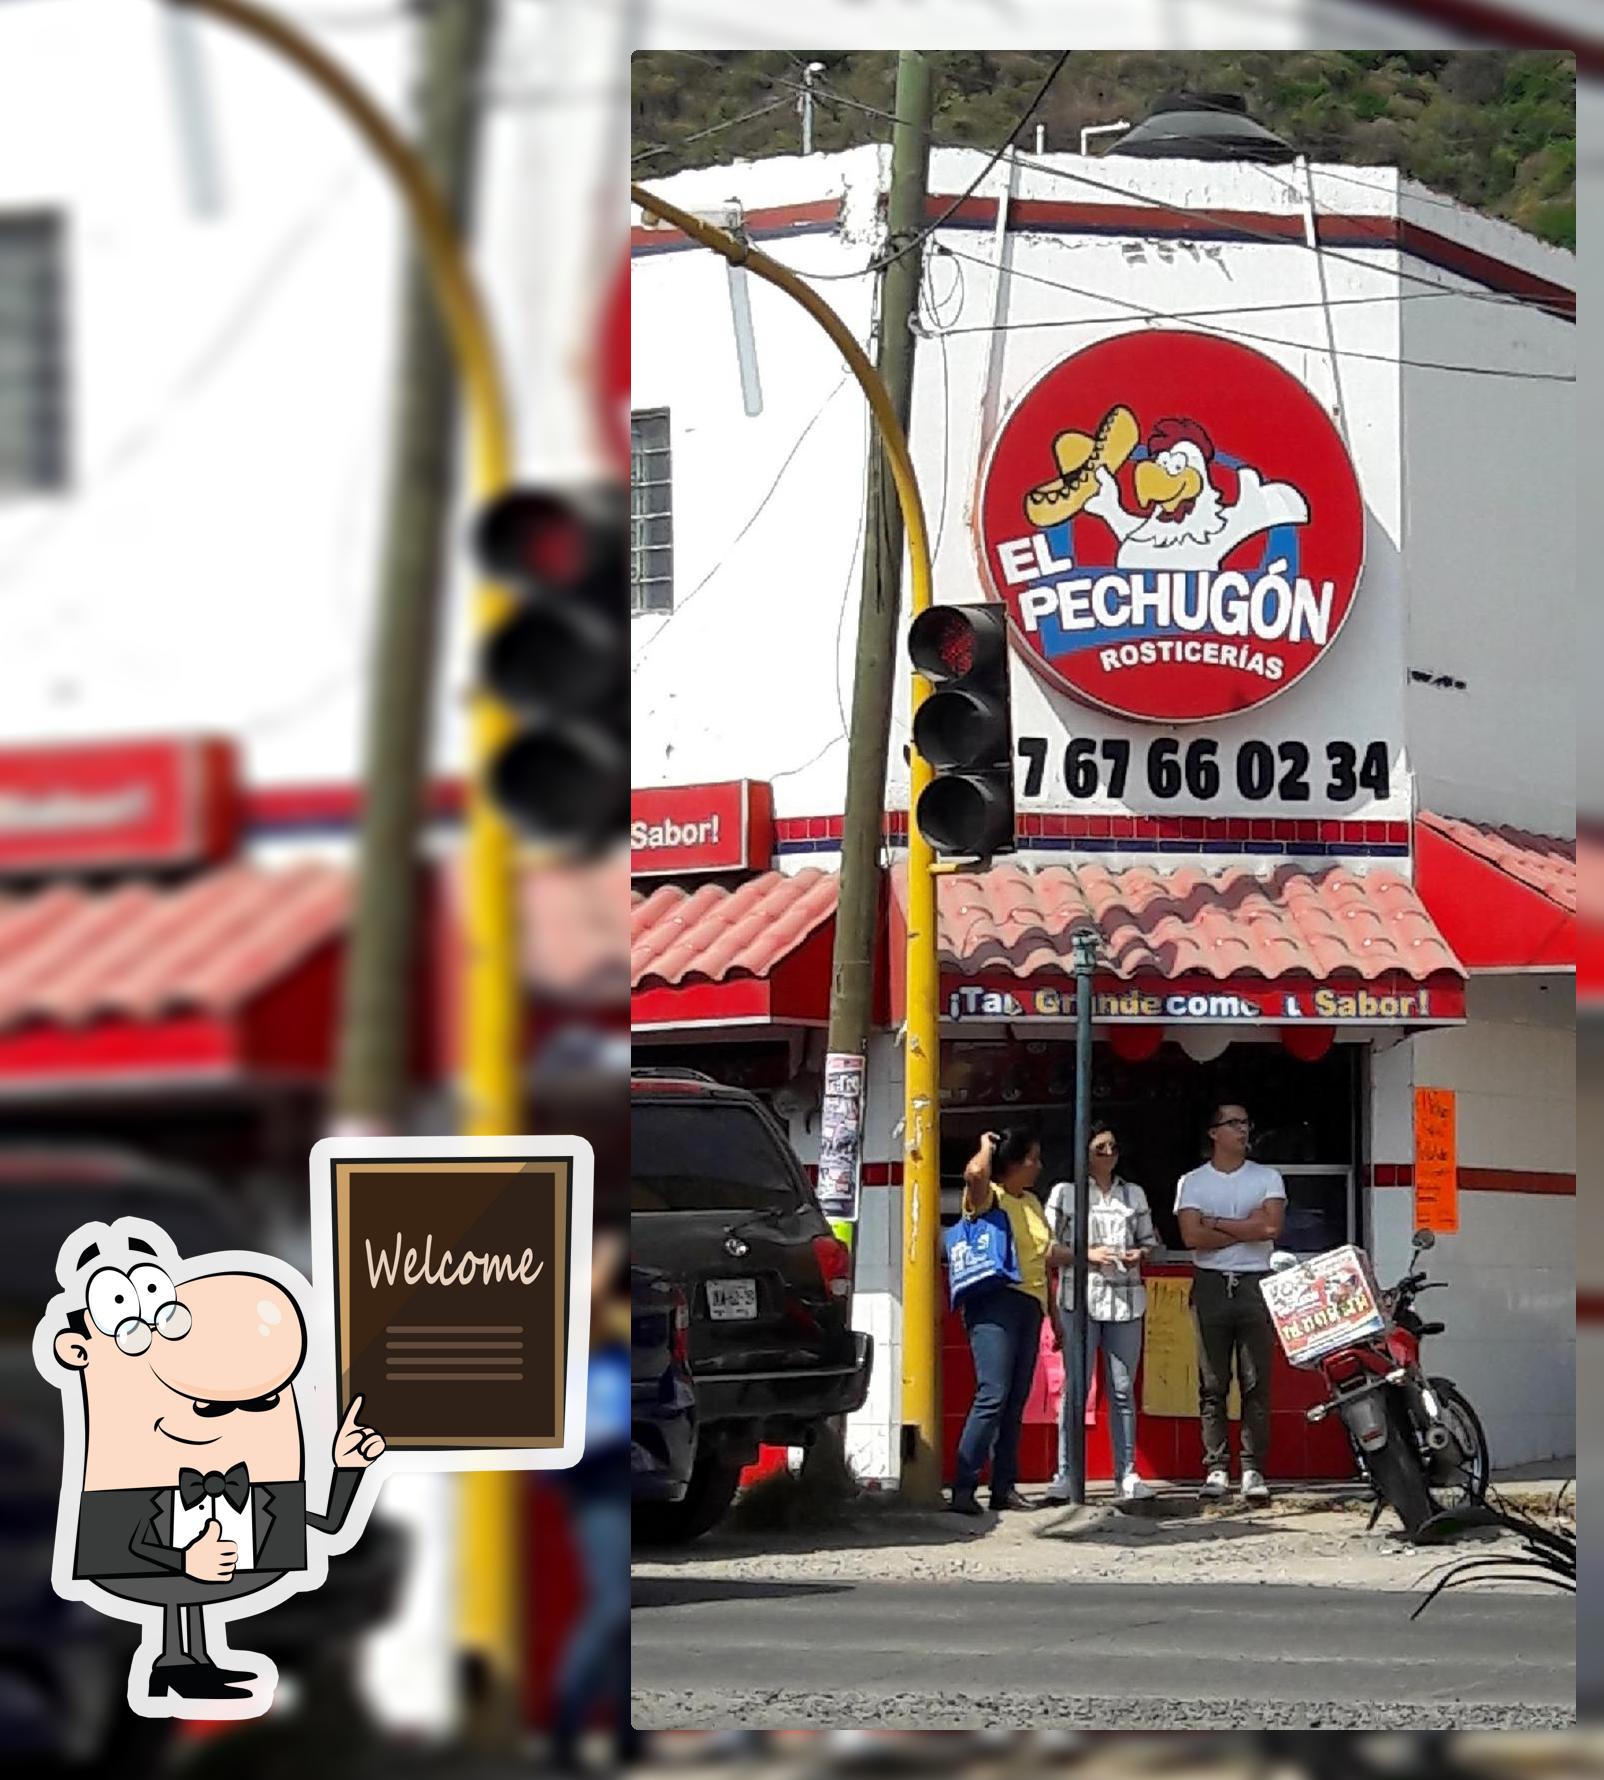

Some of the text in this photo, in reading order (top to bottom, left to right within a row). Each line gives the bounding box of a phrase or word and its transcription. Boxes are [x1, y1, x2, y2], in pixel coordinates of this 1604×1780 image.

[996, 533, 1073, 586] EL
[1018, 559, 1335, 646] PECHUGÓN
[1100, 640, 1285, 681] ROSTICERÍAS
[1017, 737, 1390, 801] 7 67 66 02 34
[631, 814, 719, 850] Sabor!
[1315, 989, 1429, 1016] Sabor!
